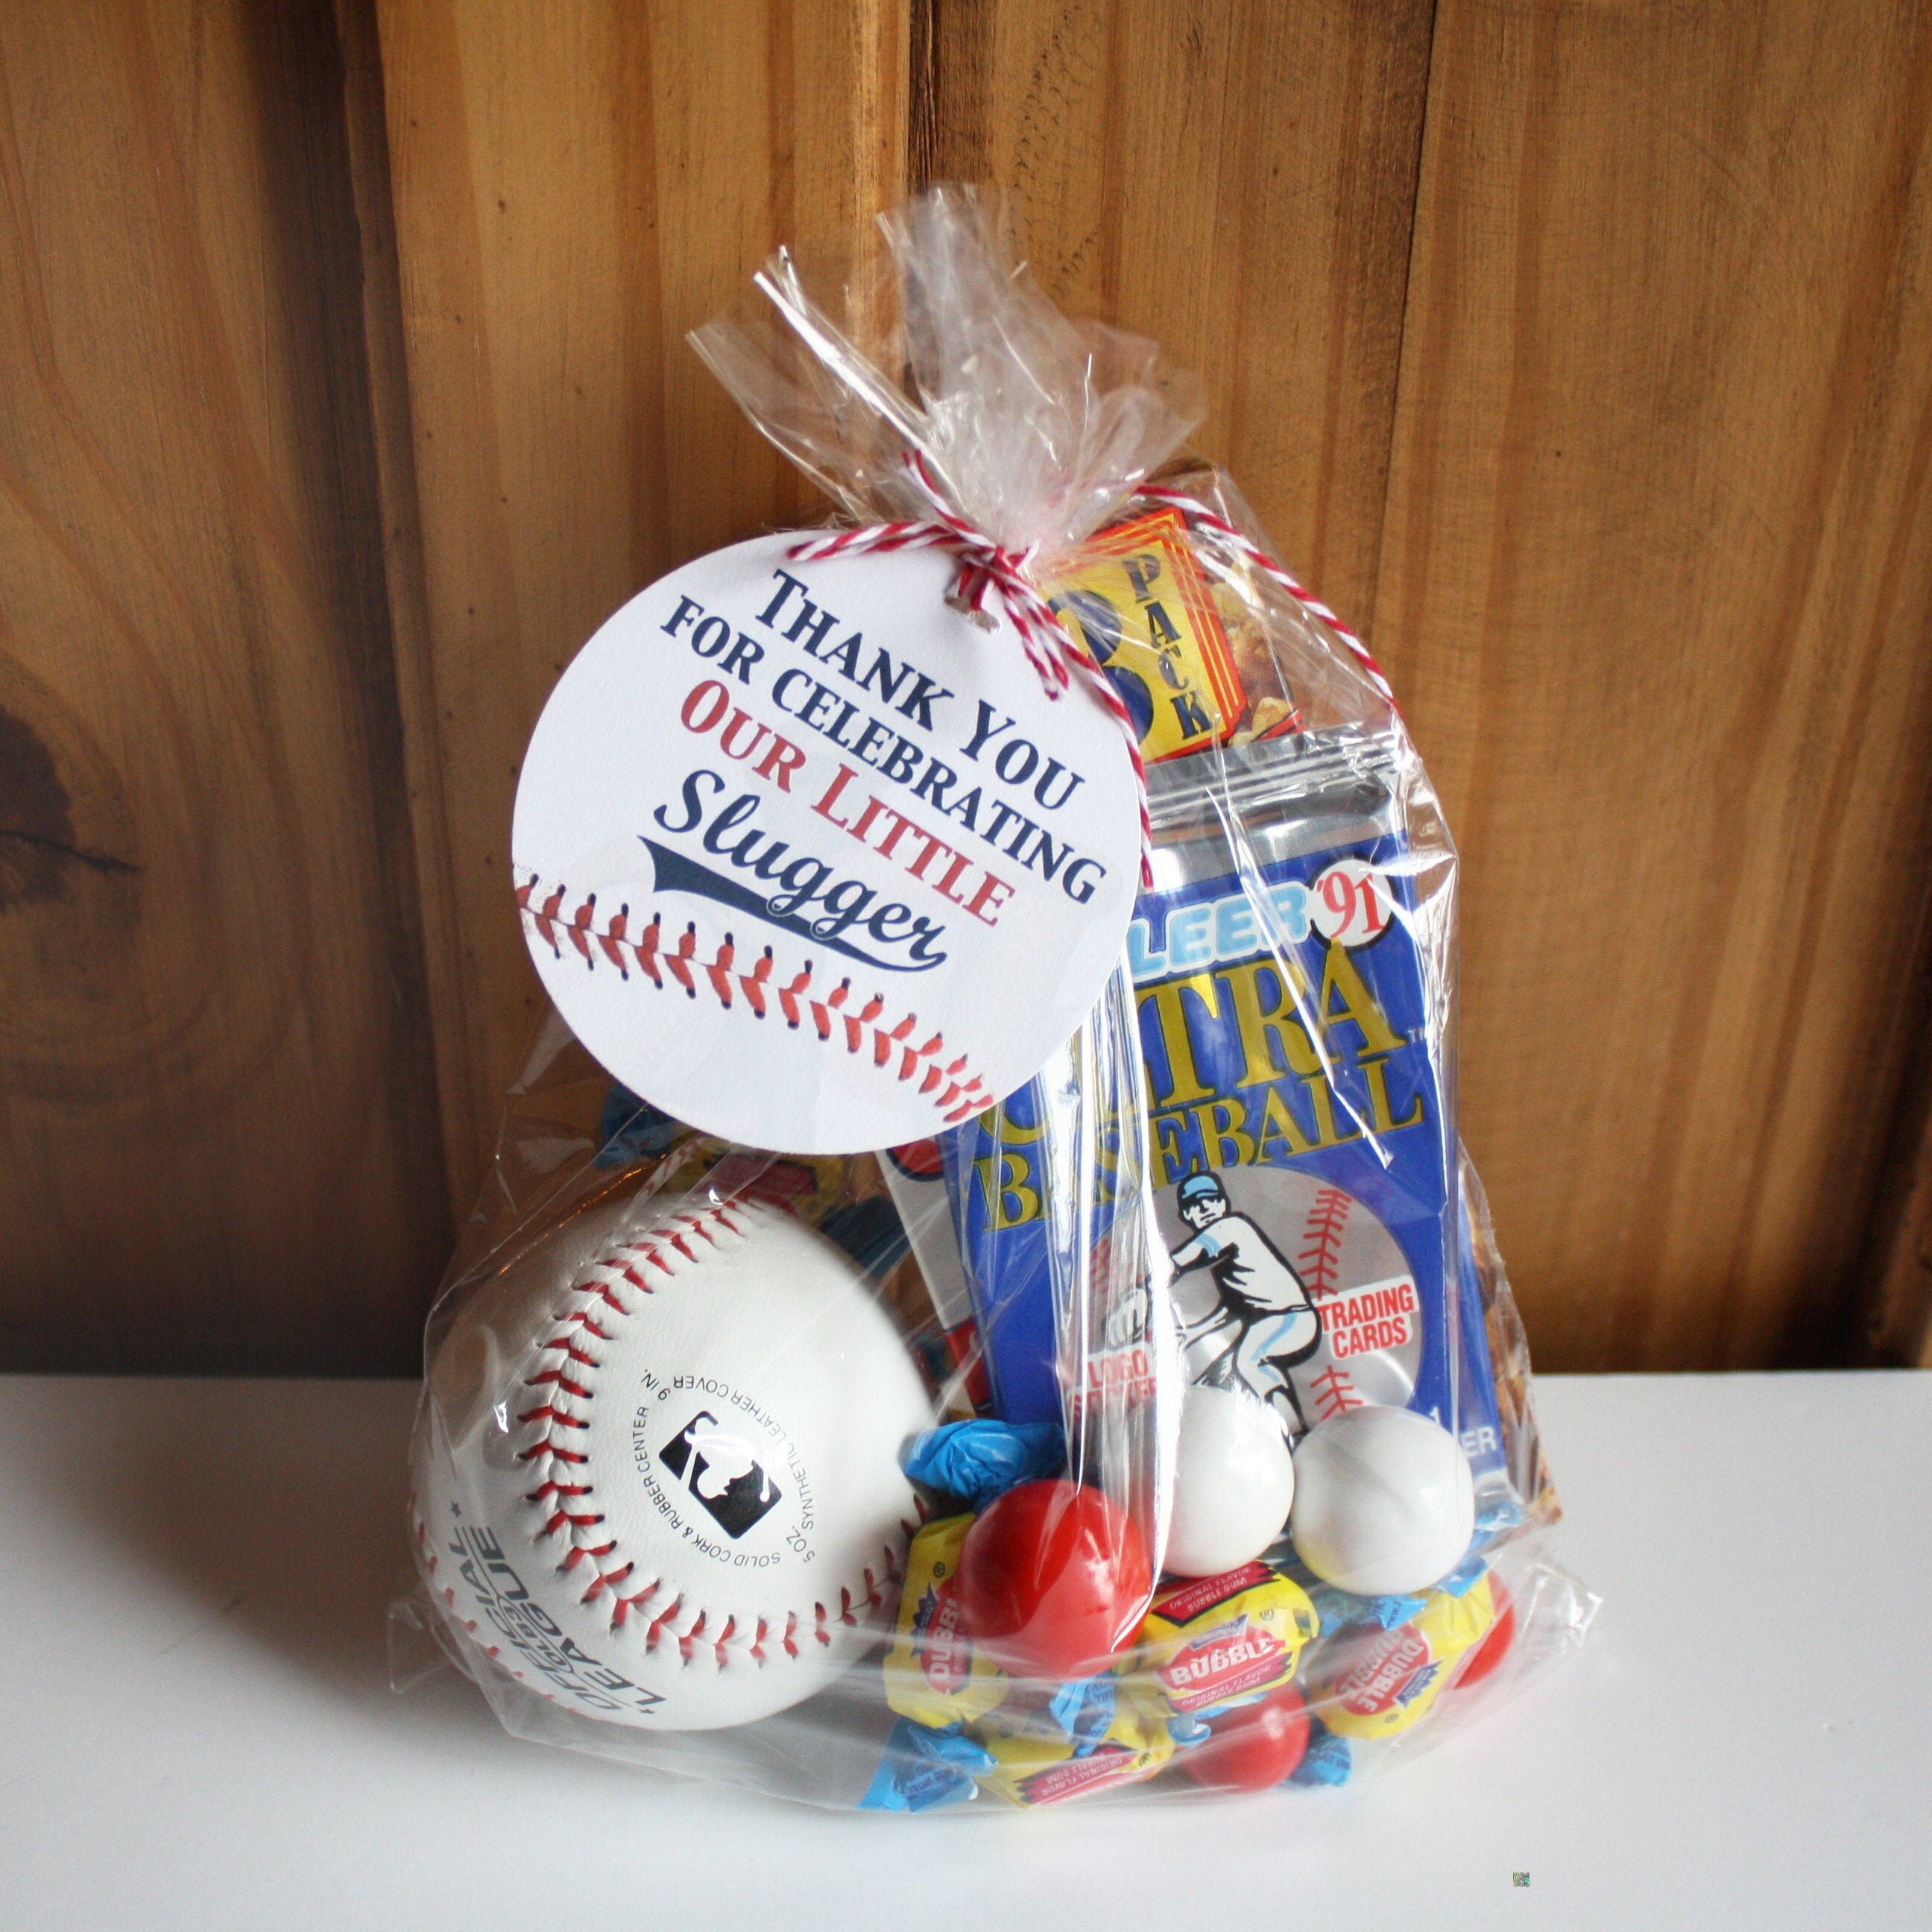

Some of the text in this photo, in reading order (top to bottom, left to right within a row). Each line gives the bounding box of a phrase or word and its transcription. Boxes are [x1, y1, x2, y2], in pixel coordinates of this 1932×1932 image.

[1122, 554, 1212, 739] PACK
[756, 569, 1085, 809] THANK YOU
[660, 595, 1106, 903] FOR CELEBRATING
[681, 680, 1016, 926] OUR LITTLE
[653, 769, 948, 963] Slugger
[1127, 885, 1306, 976] LEER
[1318, 1284, 1415, 1333] TRADING
[1333, 1316, 1407, 1358] CARDS
[640, 1368, 672, 1401] 9 IN.
[632, 1406, 781, 1568] SOLID CORK & RUBBER CENTER
[673, 1375, 814, 1531] SYNTHETIC LEATHER COVER
[785, 1525, 815, 1564] 5 OZ.
[449, 1526, 623, 1710] OFFICIAL
[469, 1526, 667, 1705] LEAGUE
[1169, 1566, 1253, 1610] ORIGINAL FLAVOR
[1187, 1576, 1248, 1612] BUBBLE GUM
[929, 1598, 960, 1680] DUBB
[1170, 1638, 1278, 1686] BUBBLE
[1338, 1629, 1407, 1696] BUBBLE
[1357, 1638, 1426, 1713] DUBBLE
[1181, 1683, 1230, 1707] ORIGINAL
